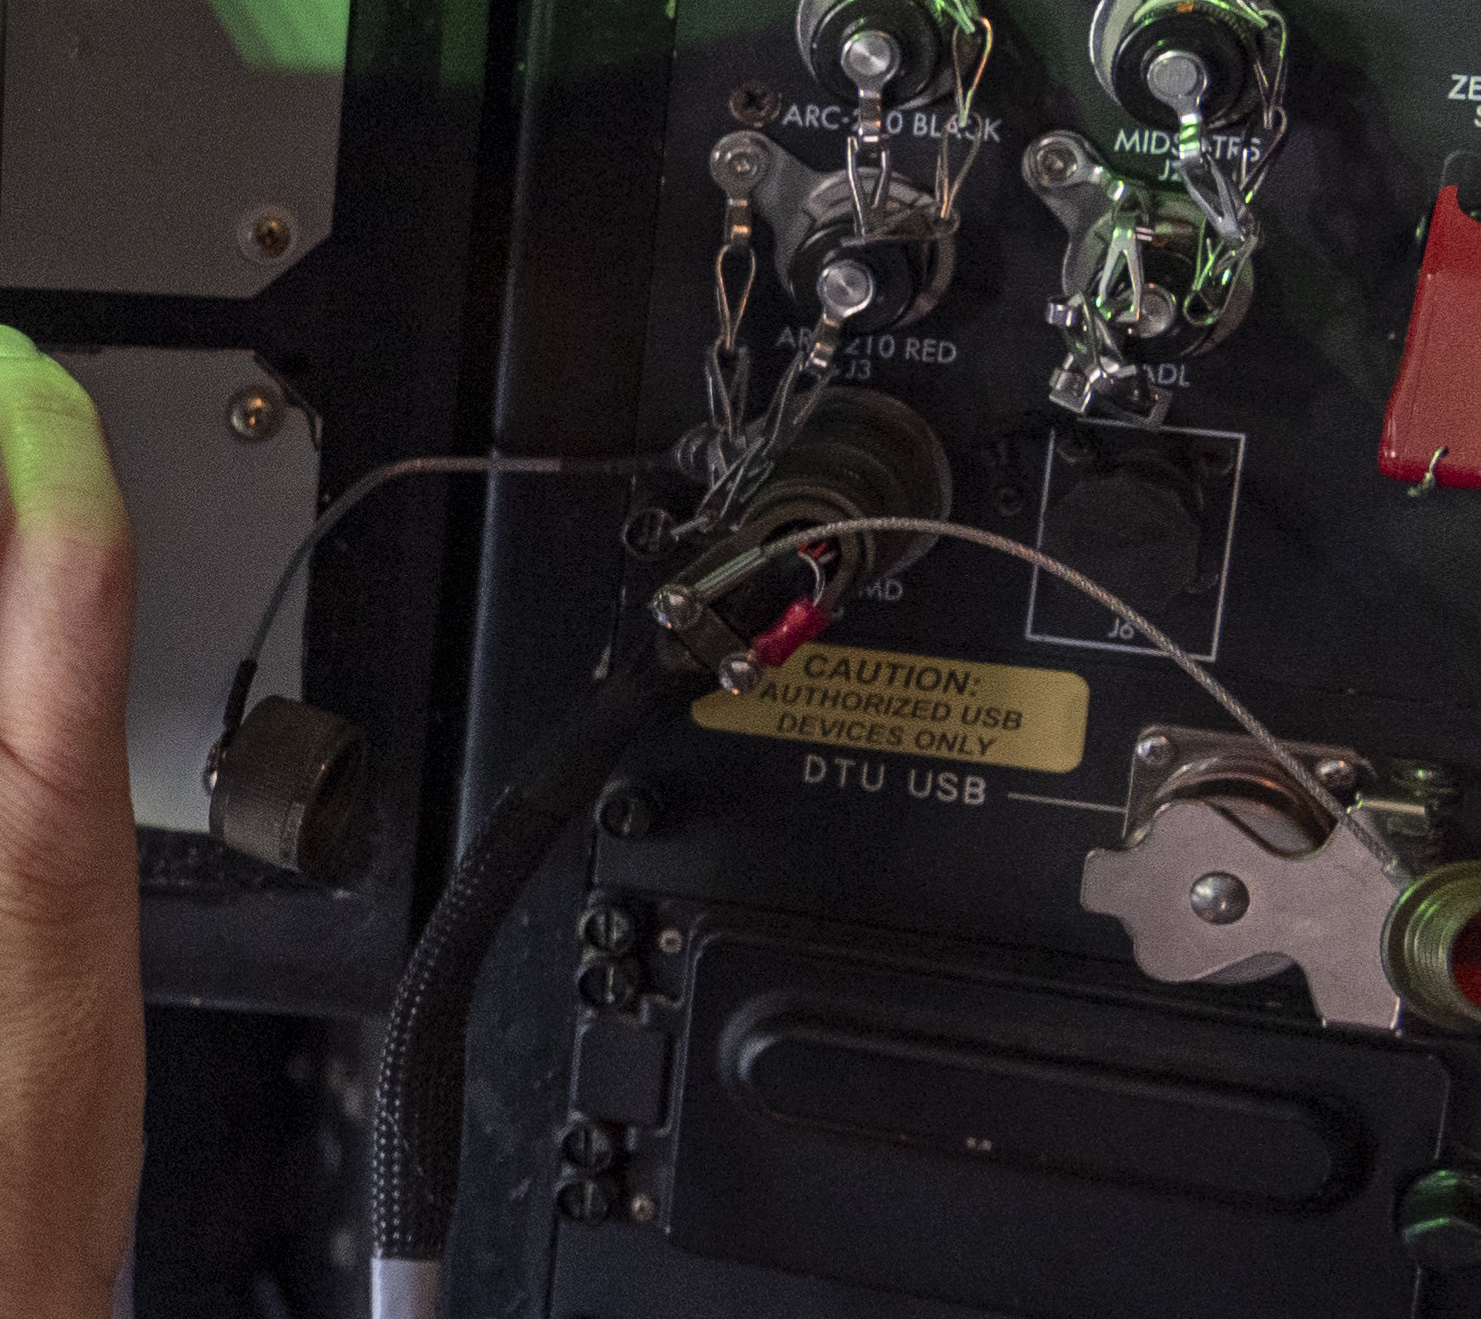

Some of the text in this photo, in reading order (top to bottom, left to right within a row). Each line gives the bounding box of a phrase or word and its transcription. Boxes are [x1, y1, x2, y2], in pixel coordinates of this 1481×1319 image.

[782, 104, 903, 135] ARC-0
[845, 359, 872, 380] J3
[905, 338, 957, 364] RED
[803, 652, 980, 698] CAUTION:
[759, 682, 1024, 732] AUTHORIZED USB
[776, 712, 999, 759] DEVICES ONLY
[804, 754, 987, 806] DTU USB
